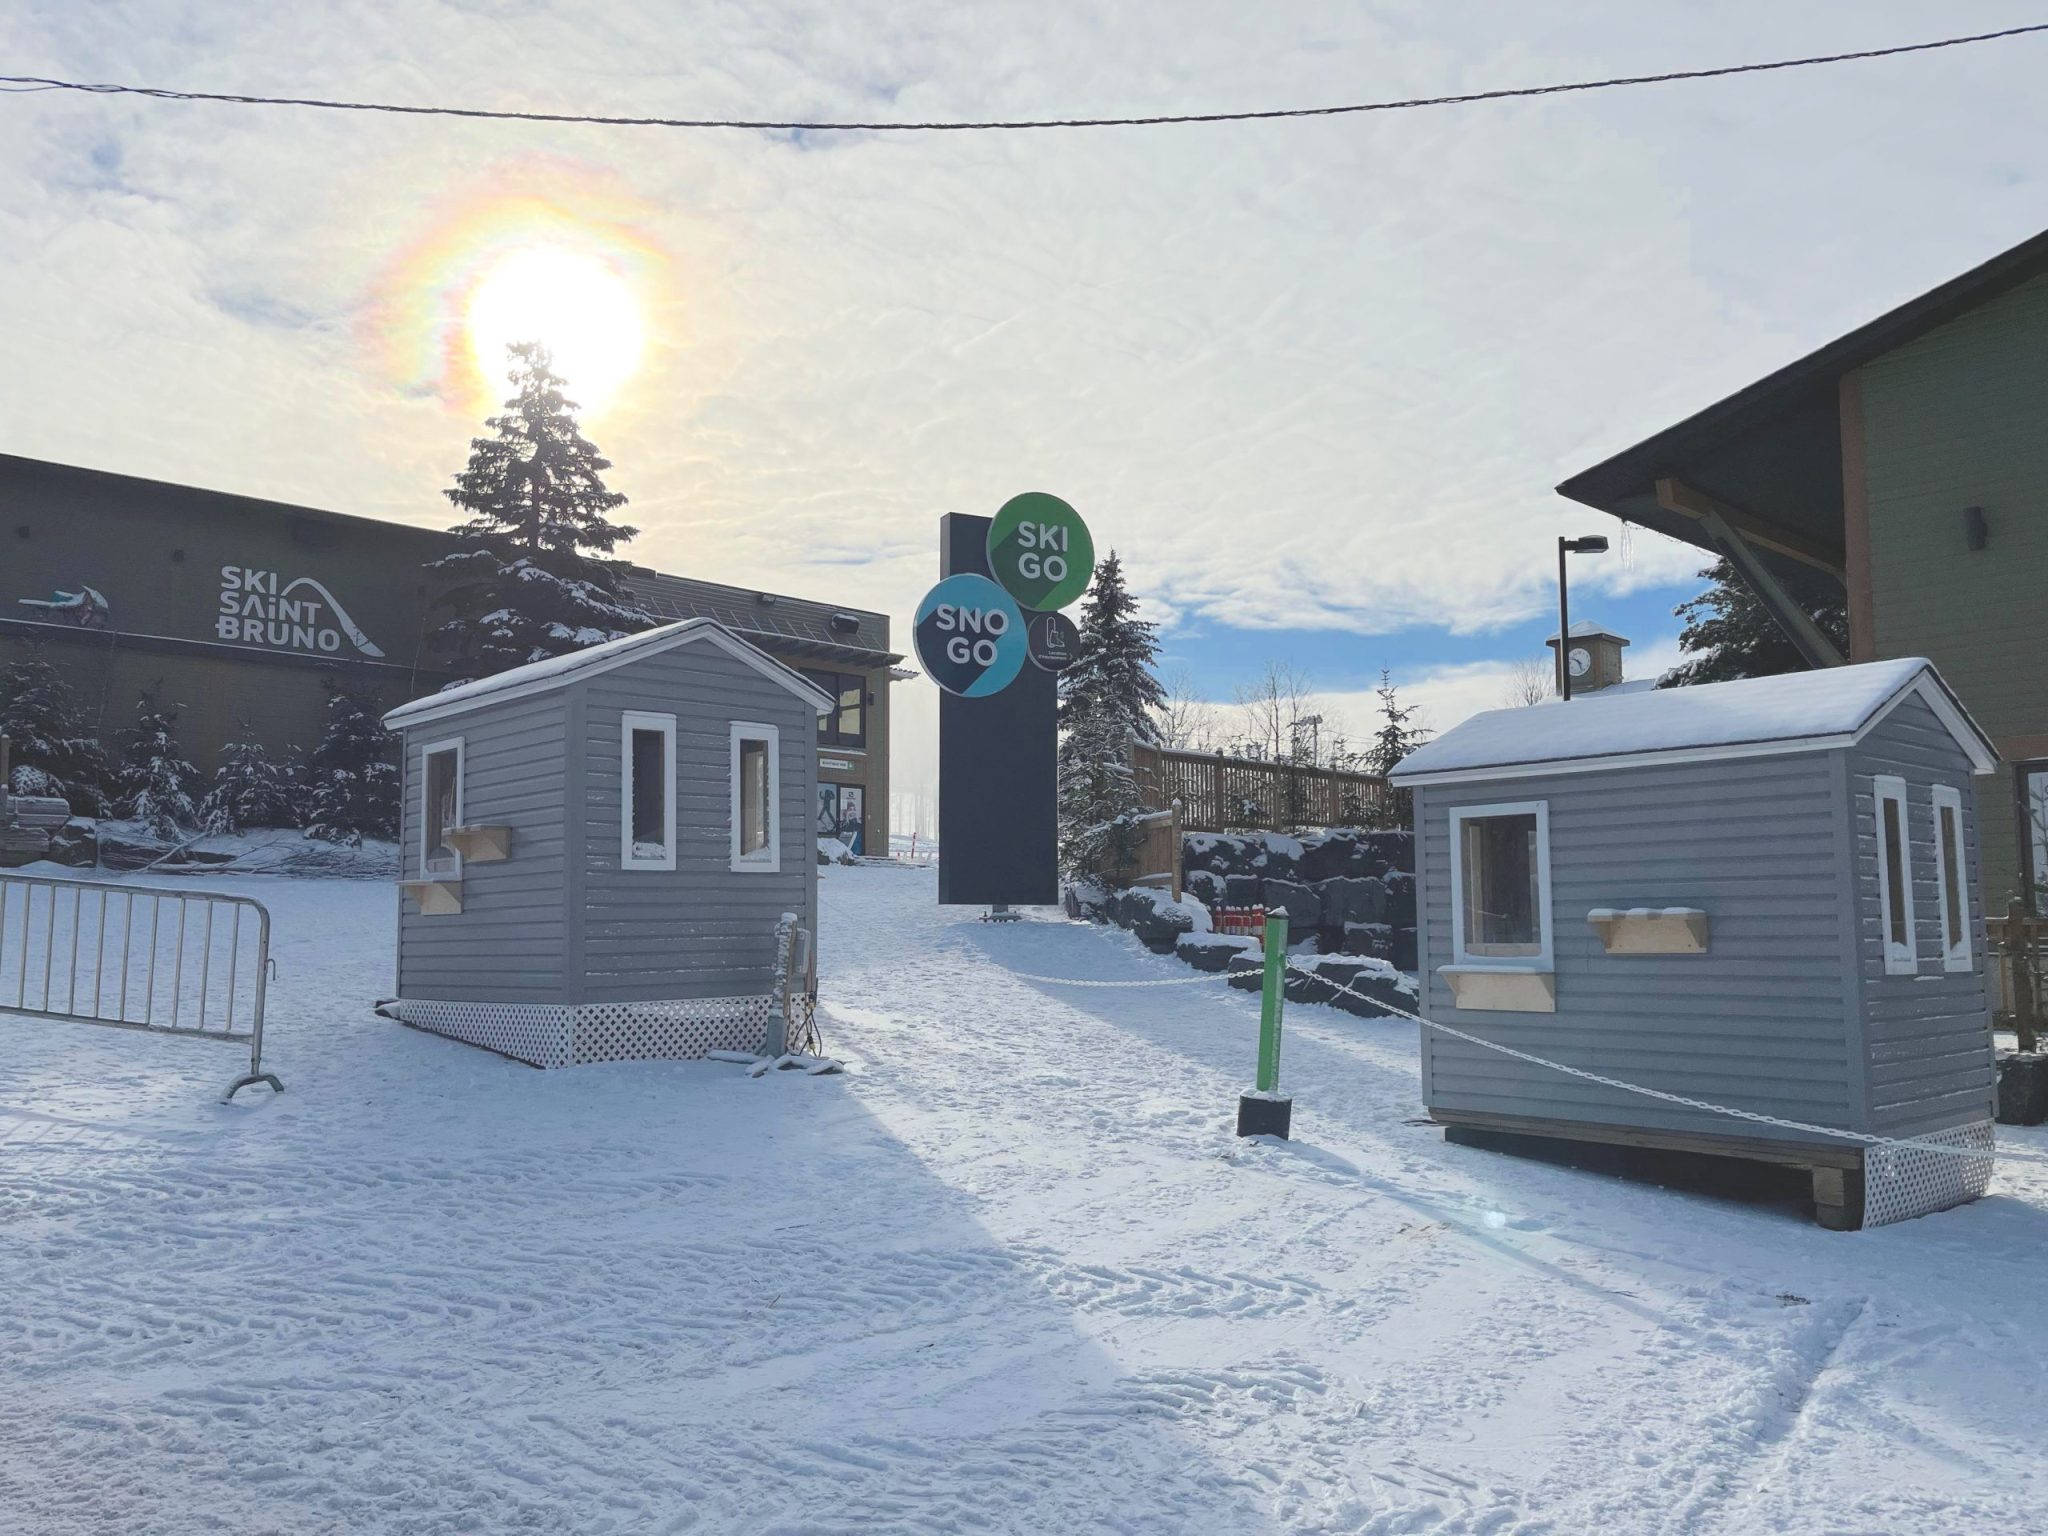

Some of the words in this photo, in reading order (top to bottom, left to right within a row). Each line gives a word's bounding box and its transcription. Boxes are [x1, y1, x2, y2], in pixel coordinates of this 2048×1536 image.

[1018, 520, 1068, 552] SKI
[220, 565, 277, 595] SKI
[1018, 552, 1068, 582] GO
[216, 615, 340, 651] BRUNO
[936, 603, 1009, 635] SNO
[947, 636, 998, 666] GO
